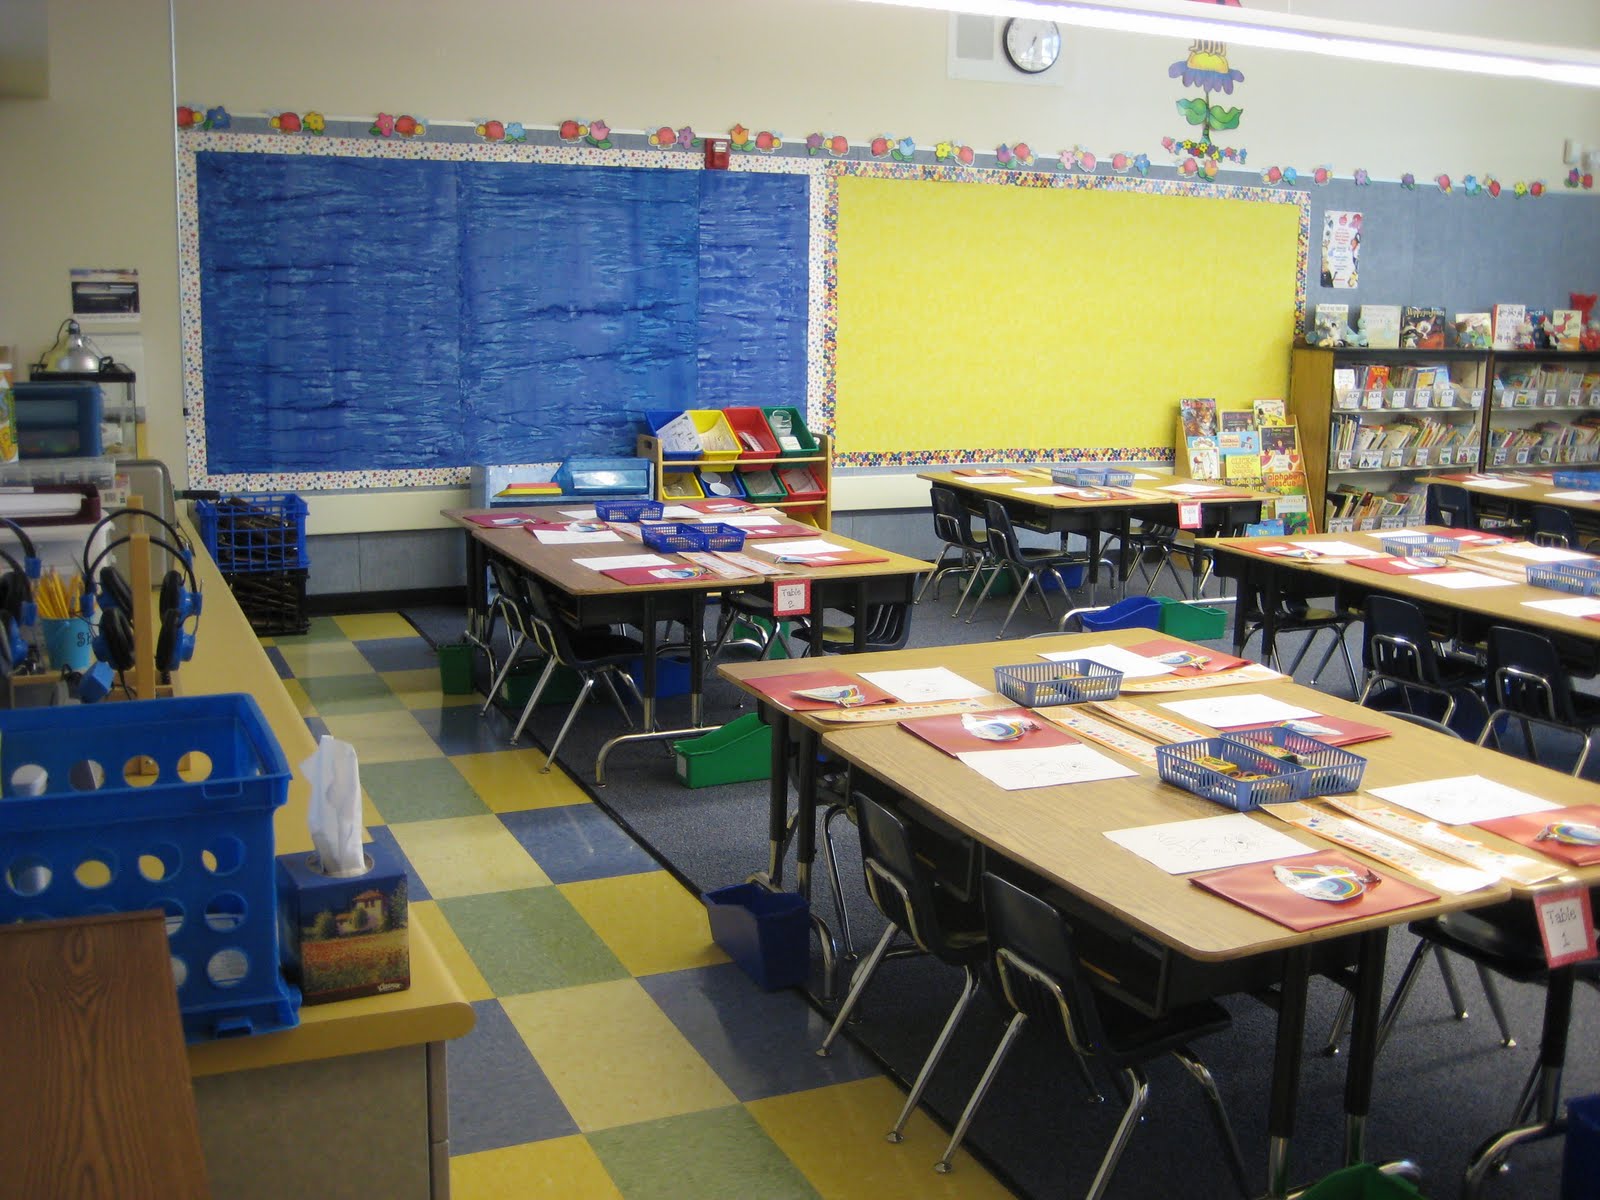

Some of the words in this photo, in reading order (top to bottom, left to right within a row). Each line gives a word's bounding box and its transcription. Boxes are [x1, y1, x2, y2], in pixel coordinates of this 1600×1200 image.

[781, 587, 802, 597] Table
[787, 600, 795, 608] 2
[1546, 906, 1577, 925] Table
[1561, 931, 1571, 948] 1
